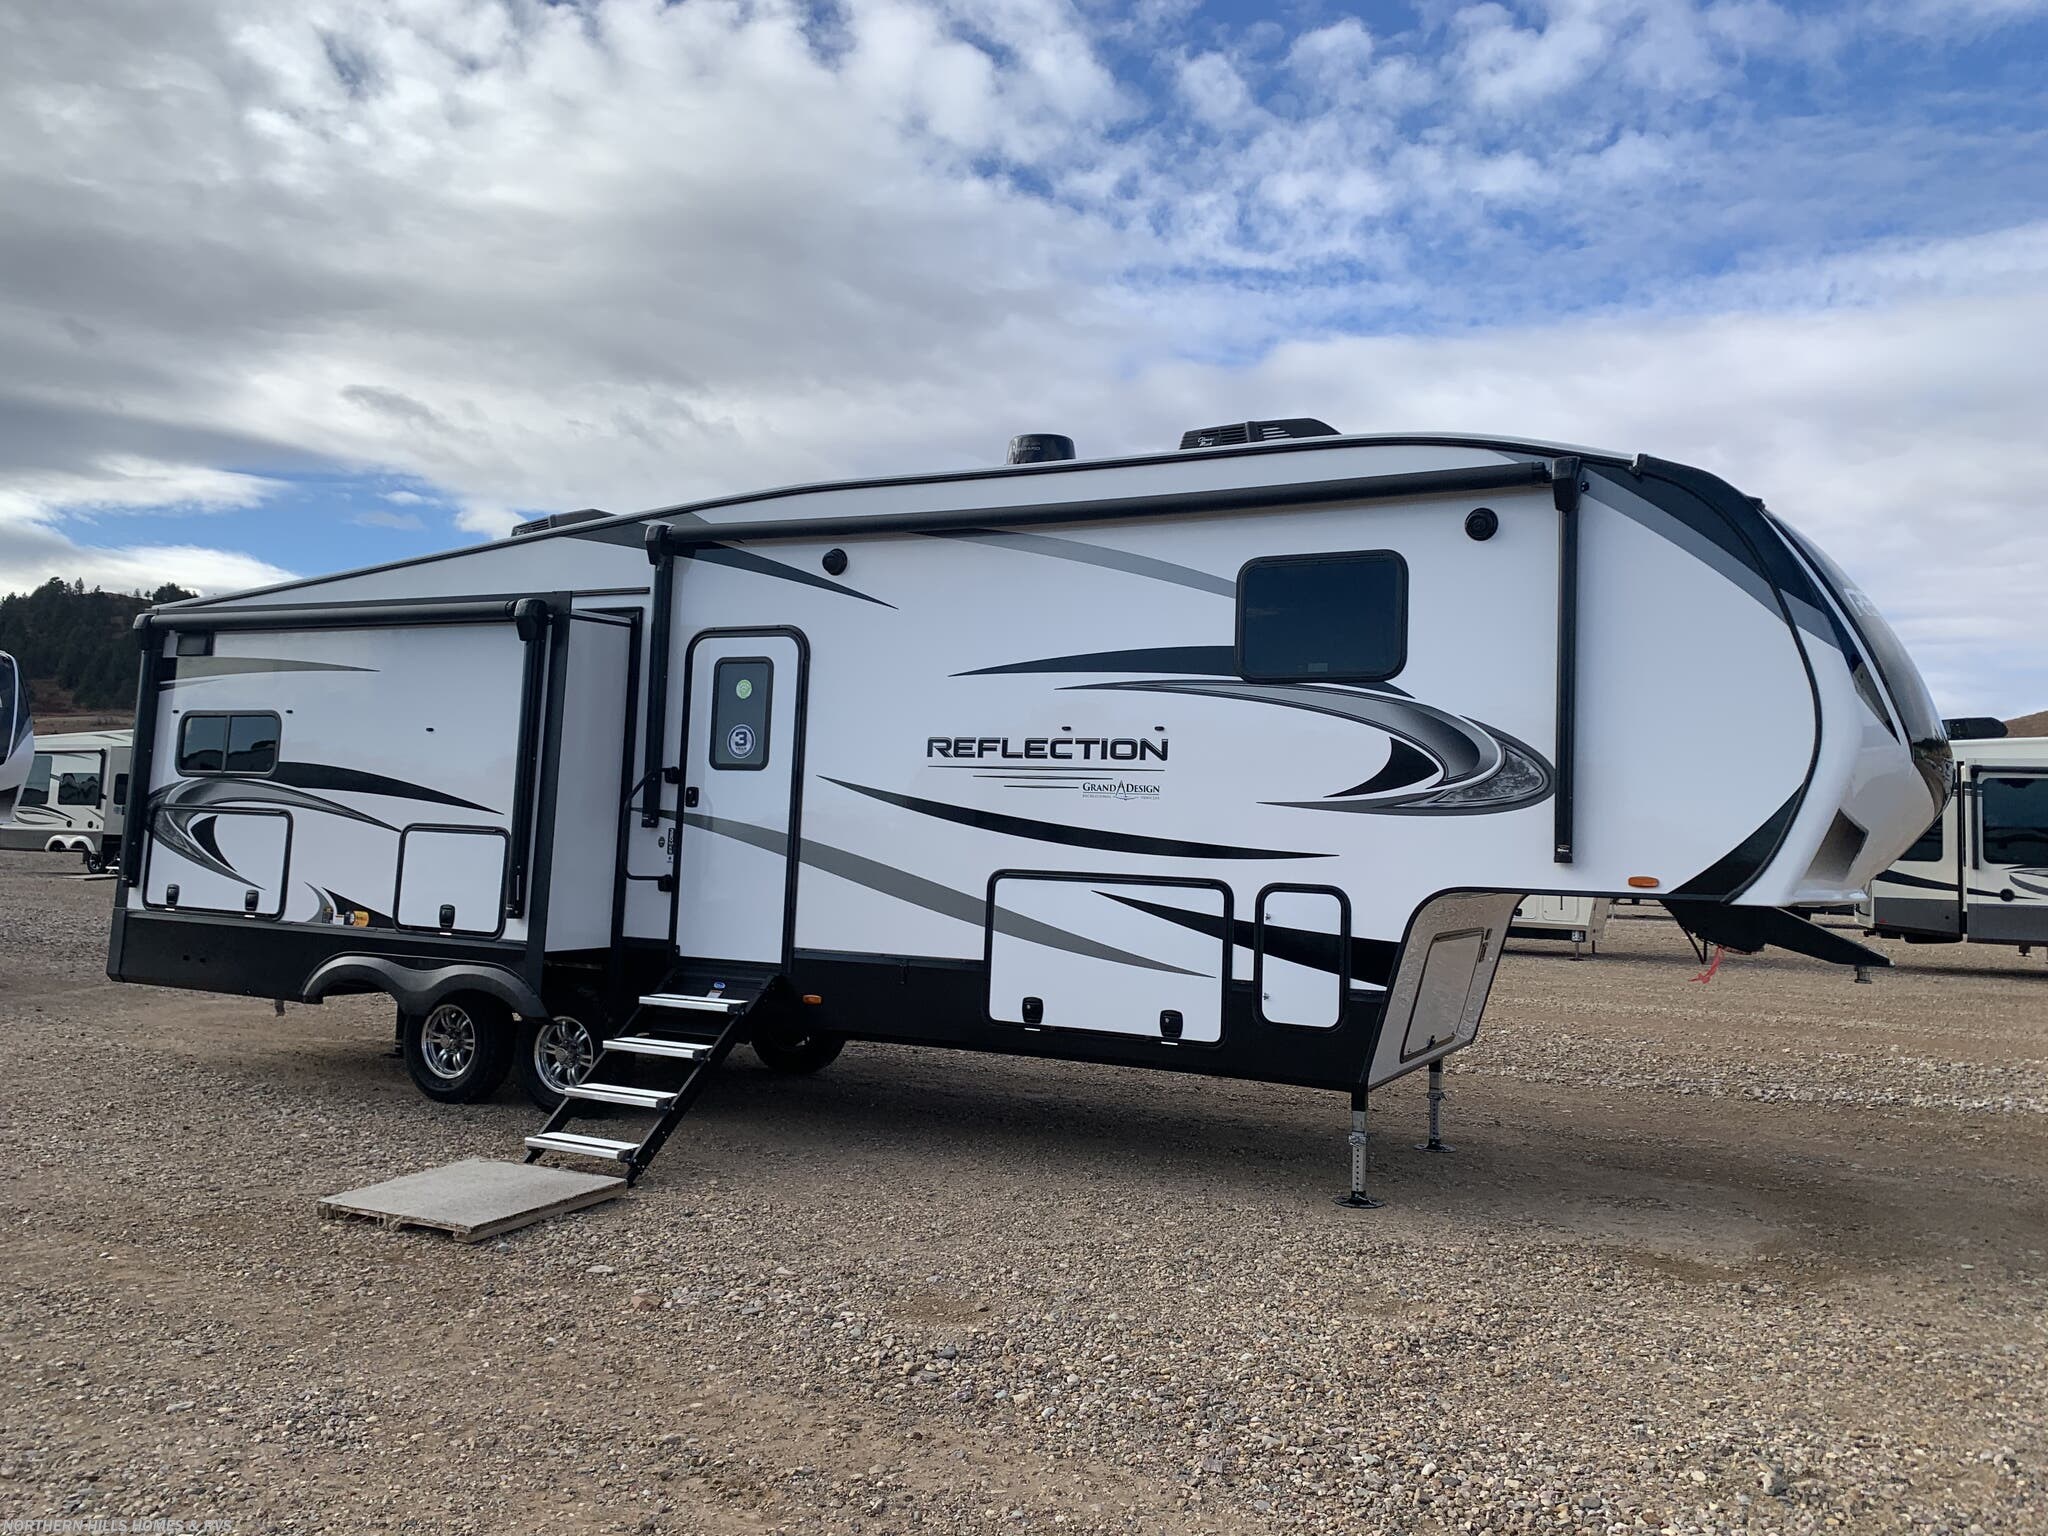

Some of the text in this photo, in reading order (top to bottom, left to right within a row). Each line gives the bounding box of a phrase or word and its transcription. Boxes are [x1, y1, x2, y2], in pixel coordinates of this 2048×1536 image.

[735, 731, 747, 747] 3
[926, 736, 1169, 762] REFLECTION
[1082, 782, 1160, 793] GRAND DESIGN
